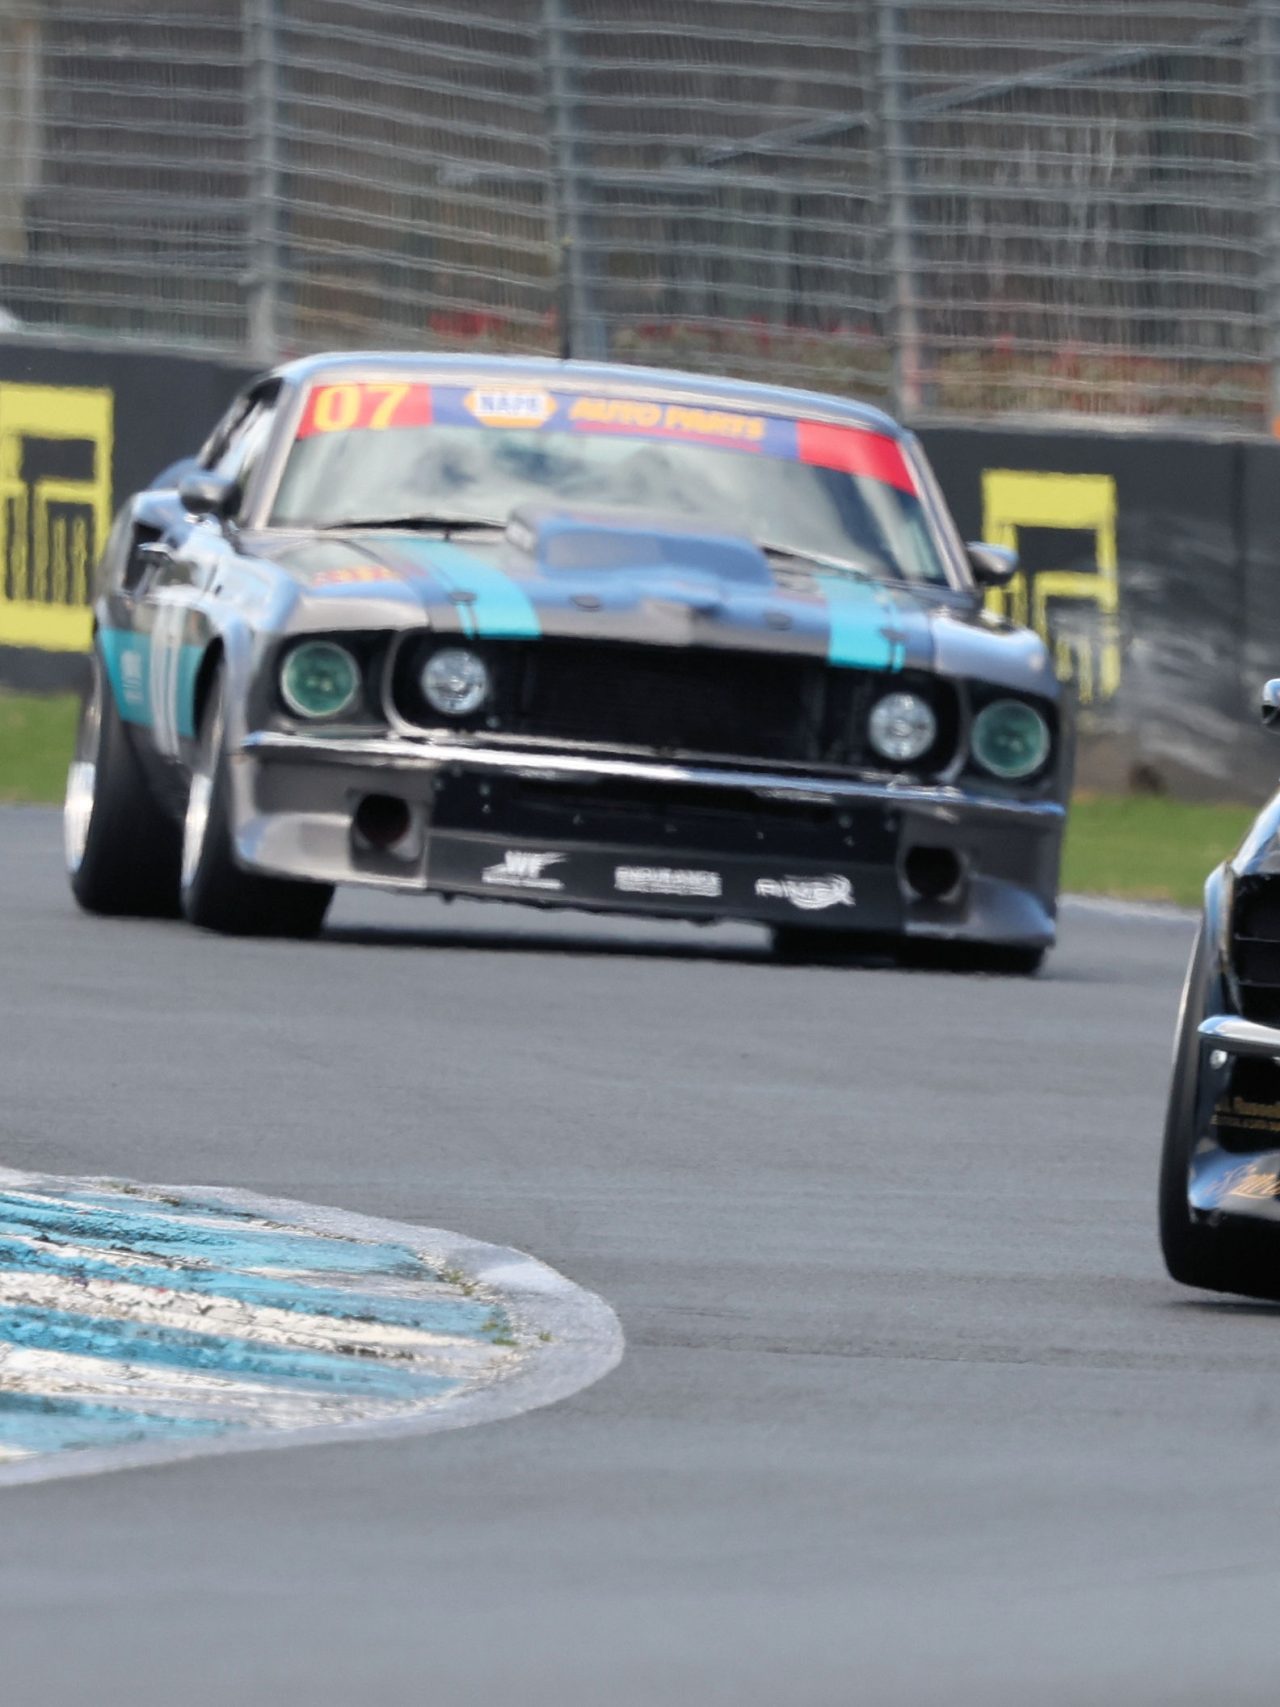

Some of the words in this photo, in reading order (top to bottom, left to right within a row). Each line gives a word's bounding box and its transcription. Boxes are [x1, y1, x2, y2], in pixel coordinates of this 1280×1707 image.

[313, 383, 411, 433] 07
[476, 391, 545, 418] NAPA
[569, 397, 661, 427] AUTO
[664, 405, 766, 440] PARTS
